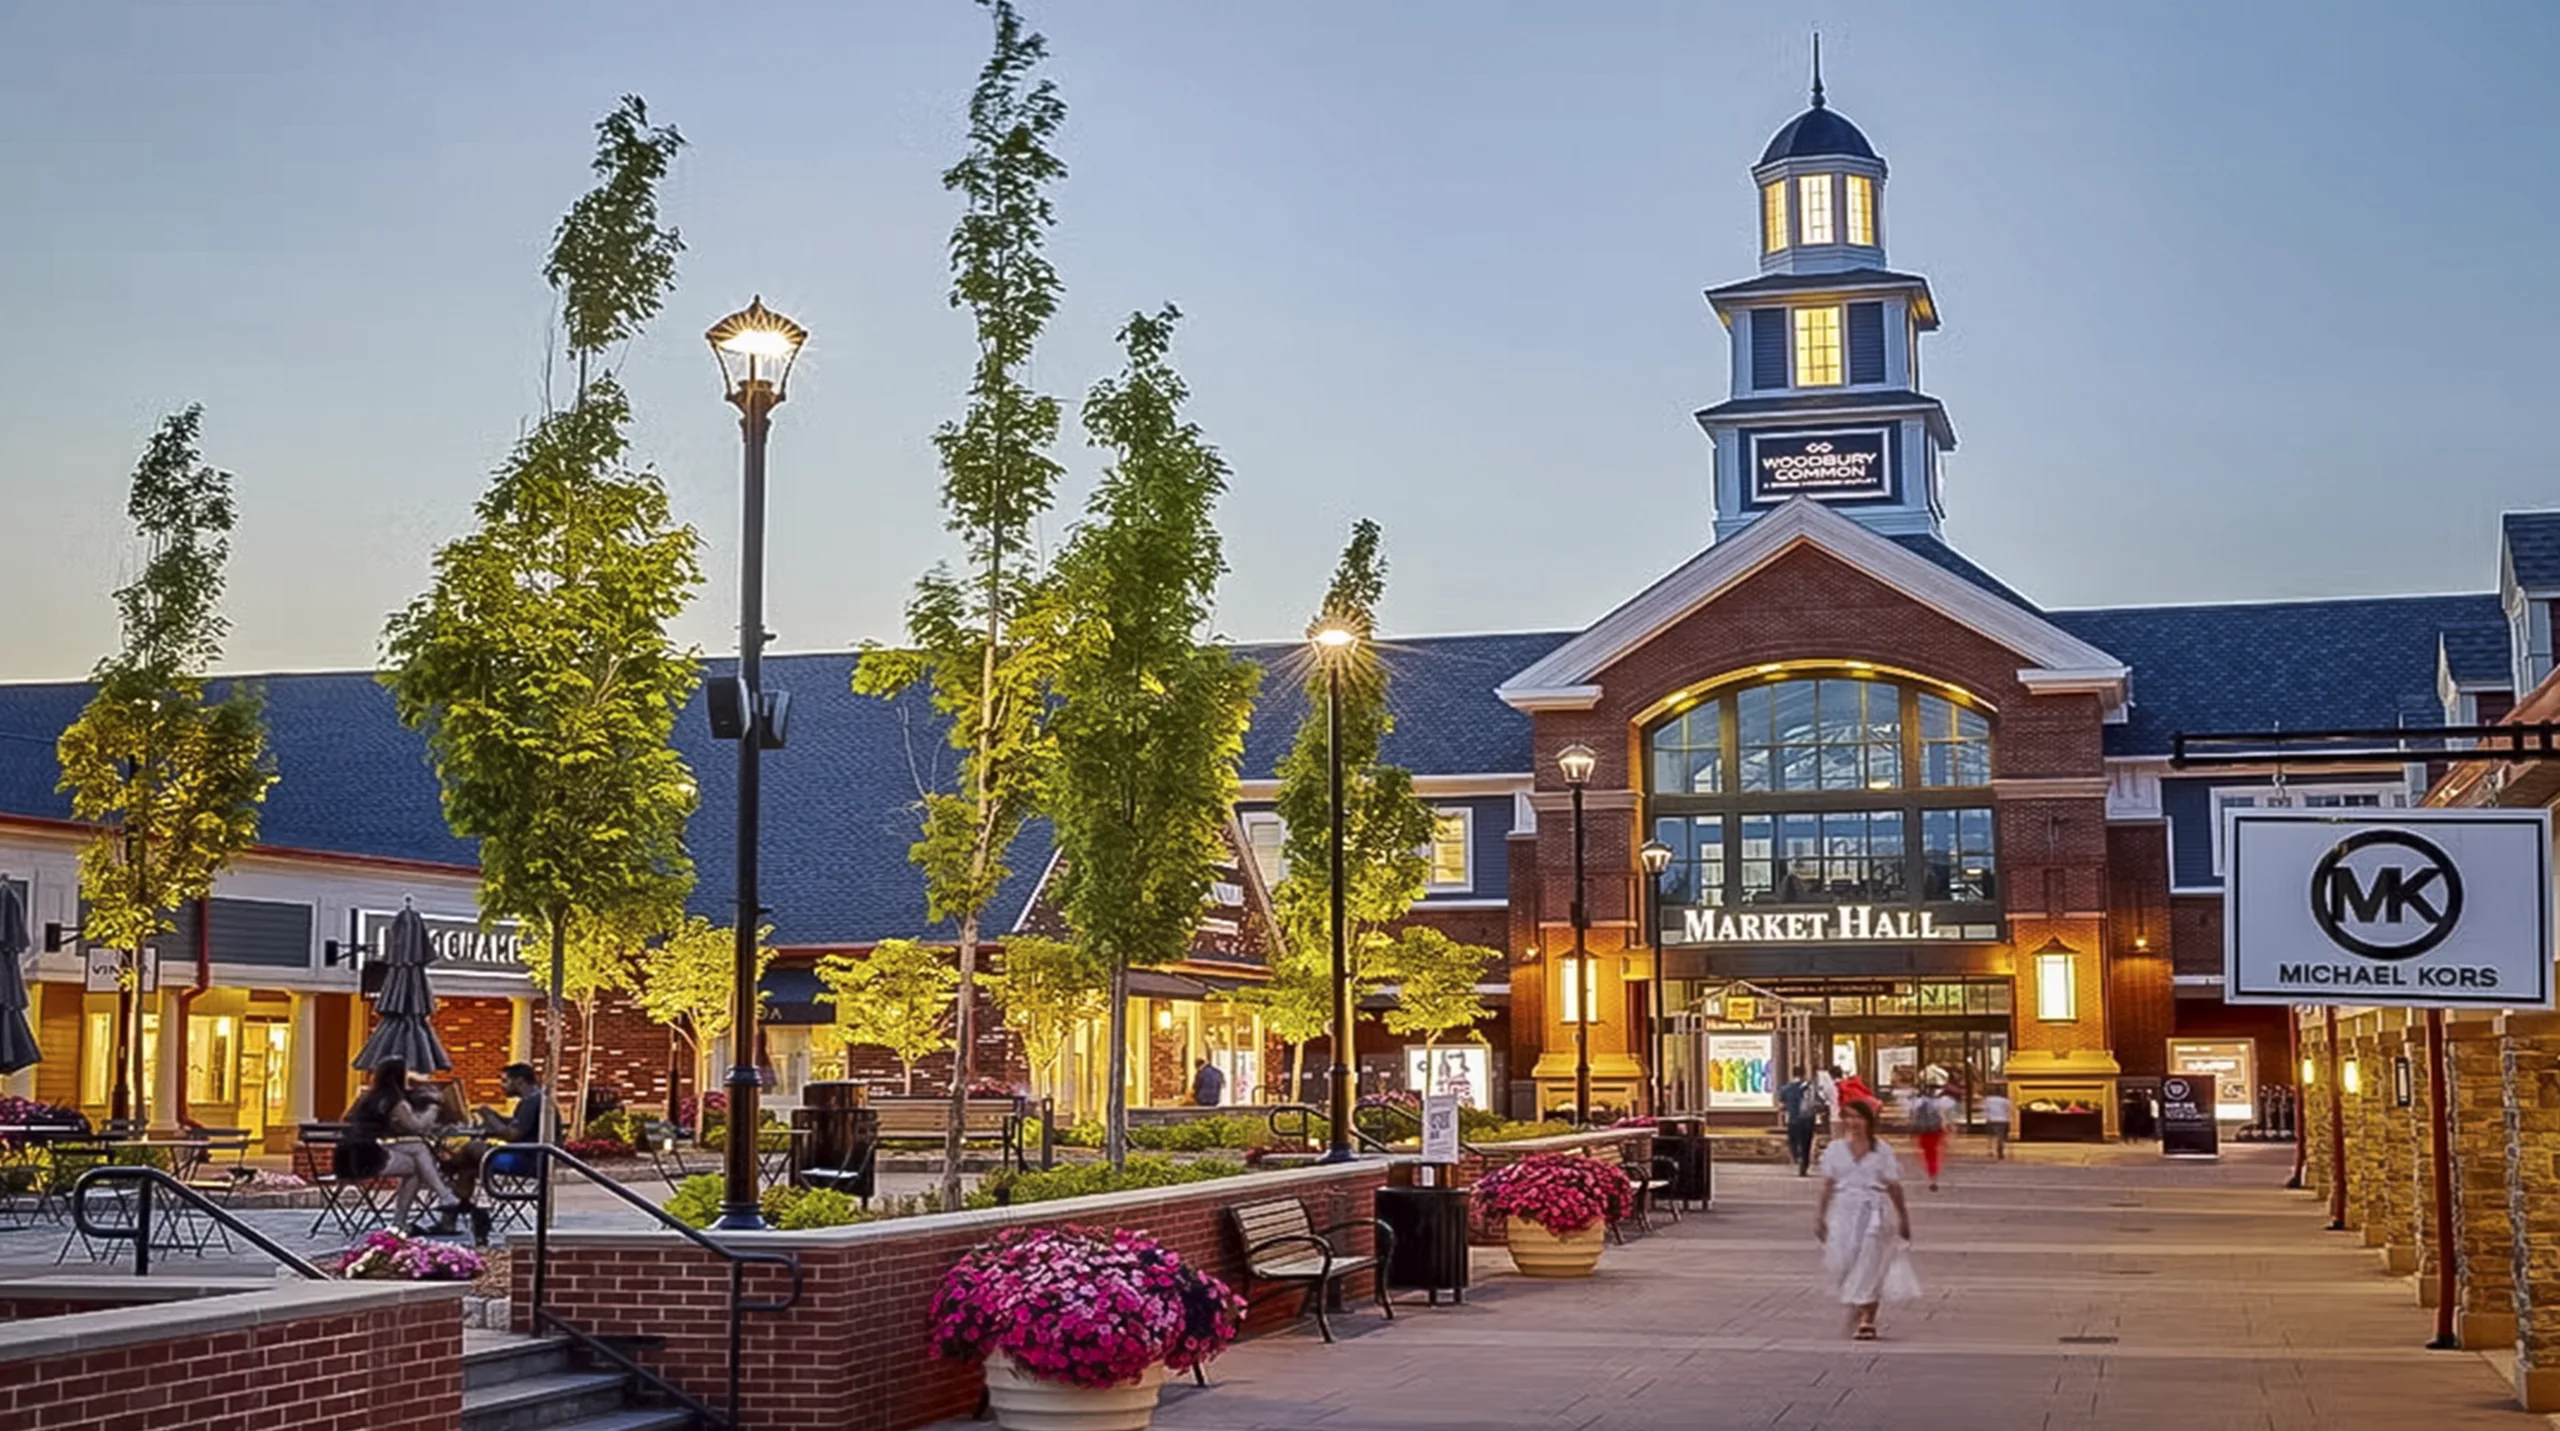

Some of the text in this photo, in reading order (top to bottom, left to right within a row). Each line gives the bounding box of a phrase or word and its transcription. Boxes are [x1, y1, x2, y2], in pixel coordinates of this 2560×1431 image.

[1762, 453, 1877, 469] WOODBURY
[1775, 465, 1866, 480] COMMON
[1684, 905, 1940, 942] MARKET HALL
[2280, 963, 2499, 988] MICHAEL KORS
